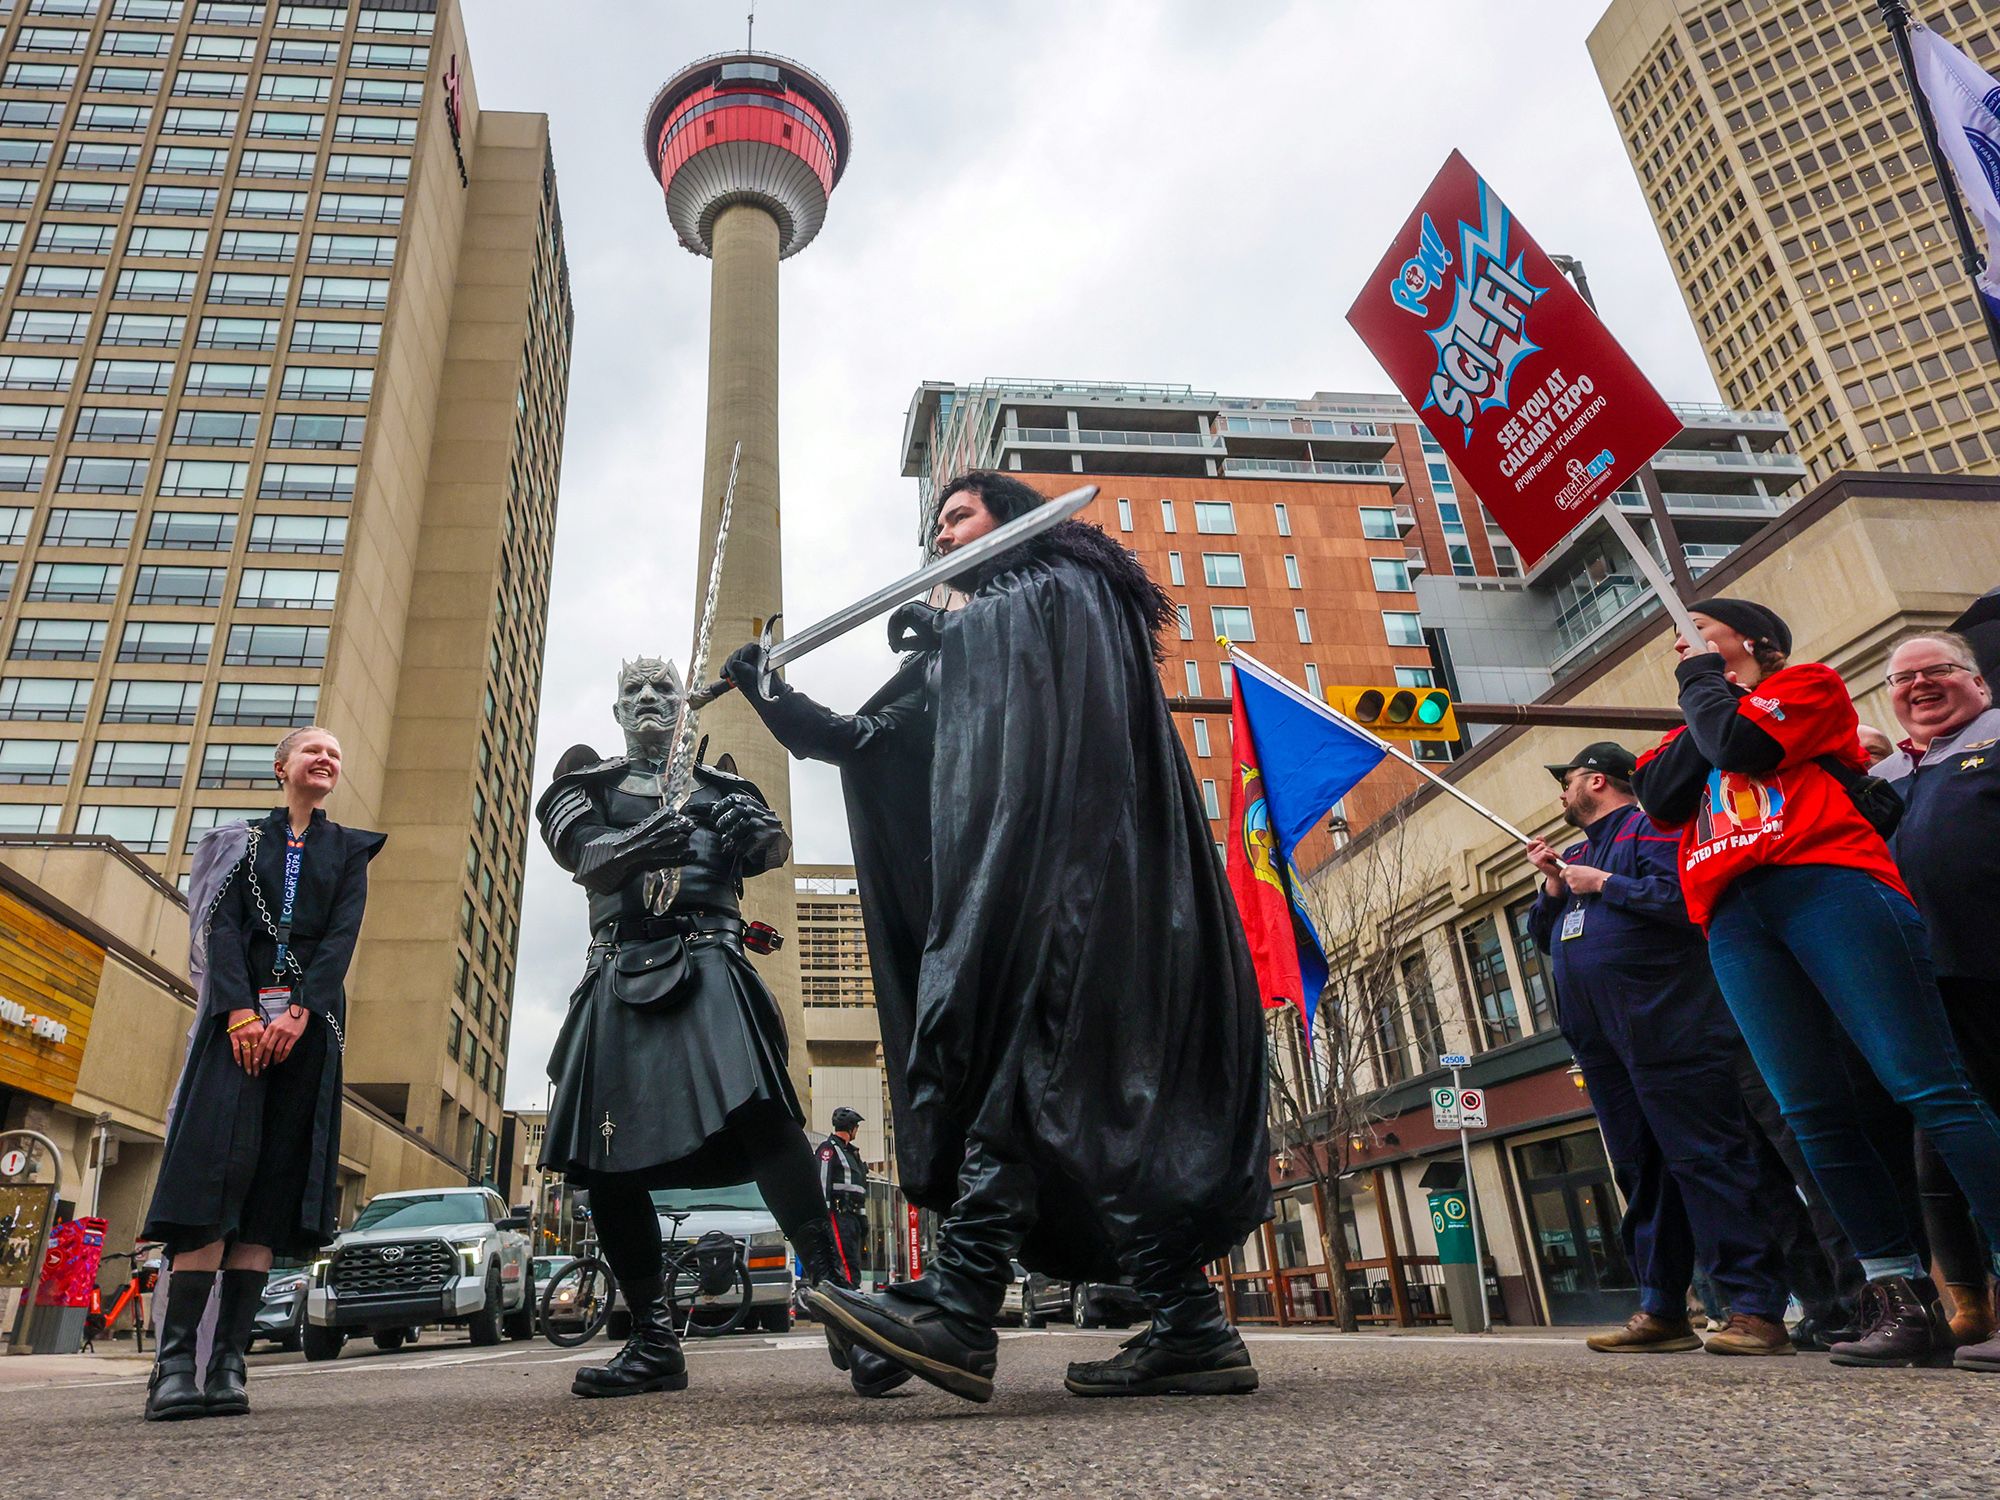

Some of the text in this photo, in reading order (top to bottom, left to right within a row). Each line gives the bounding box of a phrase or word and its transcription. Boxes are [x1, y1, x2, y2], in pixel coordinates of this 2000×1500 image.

[1980, 147, 1993, 161] FAN
[1390, 212, 1453, 318] POW!
[1430, 257, 1536, 427] SCI-FI
[1497, 368, 1568, 450] SEE YOU AT
[1499, 375, 1594, 477] CALGARY EXPO
[1514, 451, 1554, 492] #POWParade
[1555, 396, 1607, 451] #CALGARYEXPO
[1713, 838, 1728, 855] BY
[1730, 820, 1783, 848] FANOM
[283, 876, 296, 915] CALGARY
[33, 1015, 67, 1044] BAR
[1441, 1093, 1450, 1104] P
[1450, 1202, 1460, 1215] P
